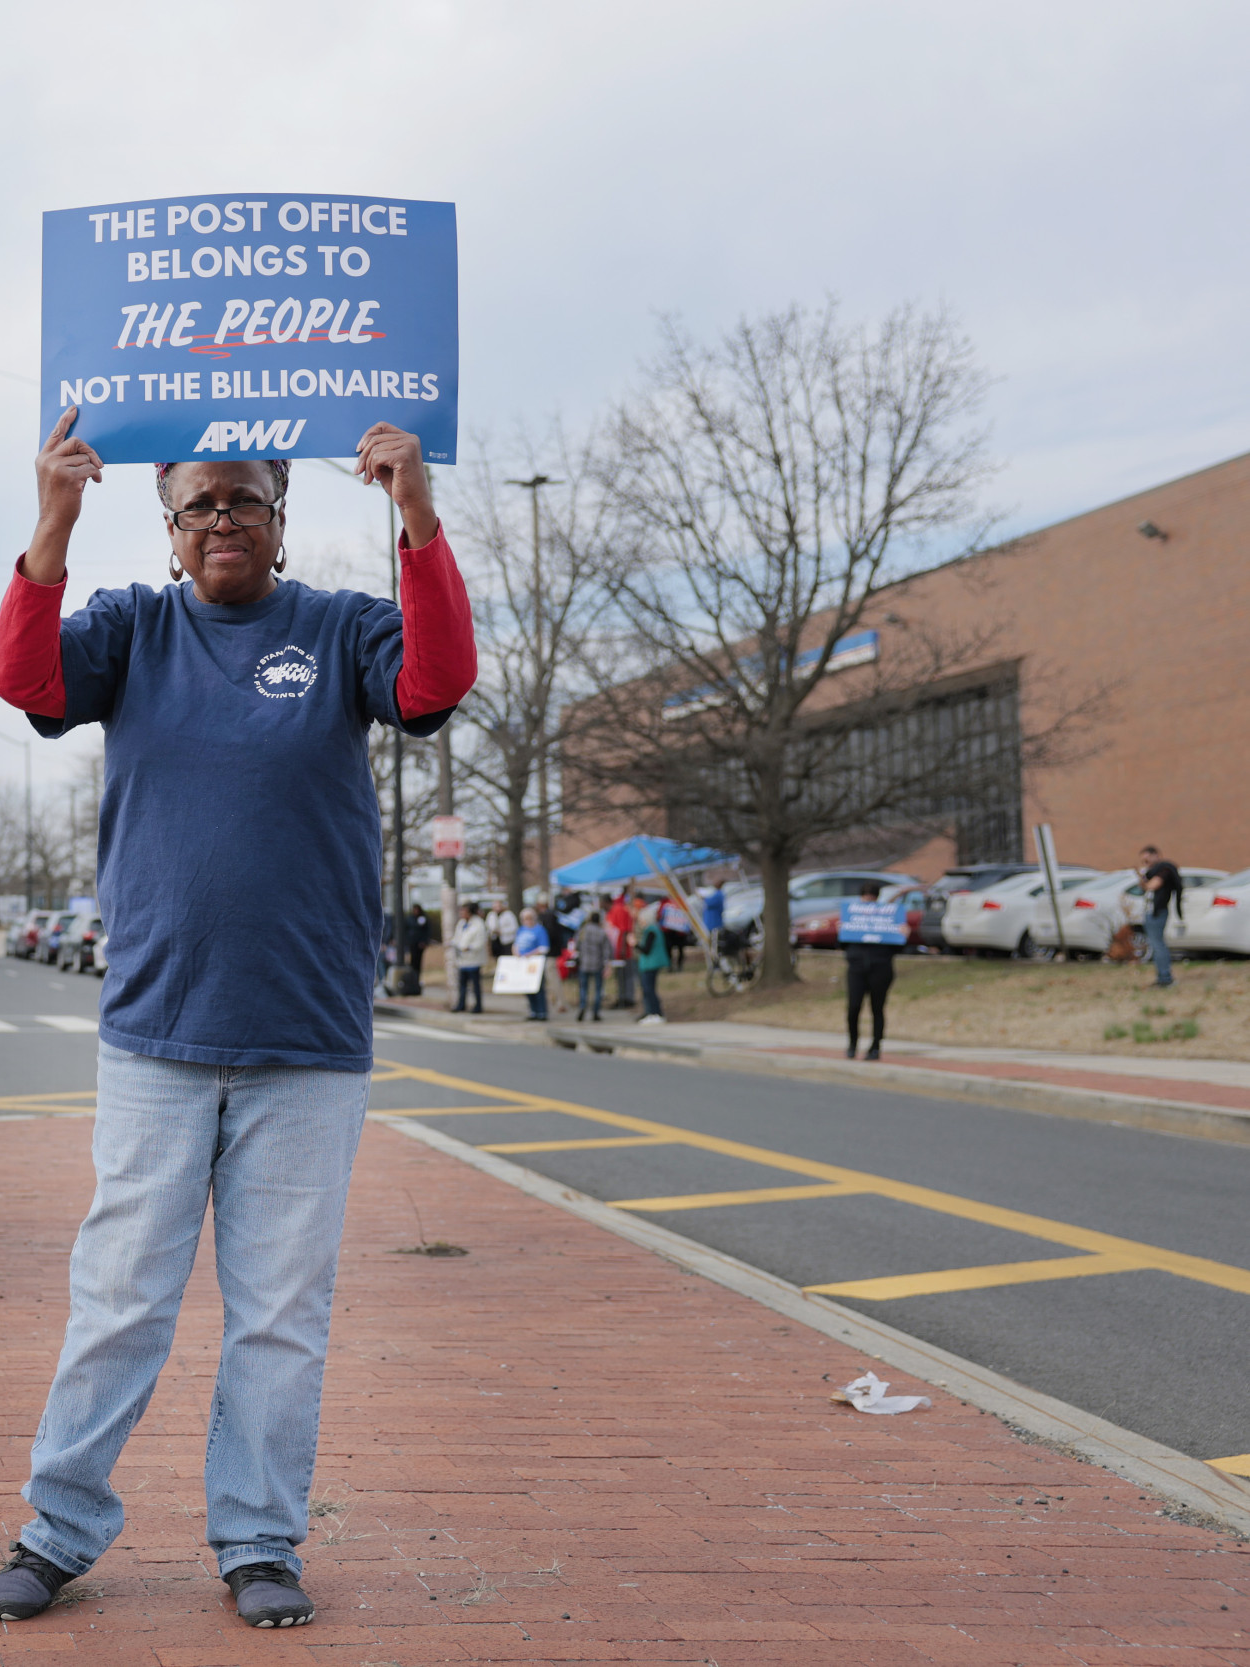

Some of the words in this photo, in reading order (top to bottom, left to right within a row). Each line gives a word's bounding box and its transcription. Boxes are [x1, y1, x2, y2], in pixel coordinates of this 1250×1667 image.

[88, 208, 156, 243] THE
[167, 201, 268, 236] POST
[278, 201, 408, 236] OFFICE
[127, 244, 308, 283] BELONGS
[317, 245, 371, 277] TO
[117, 301, 202, 350] THE
[213, 296, 381, 345] PEOPLE
[59, 375, 130, 407] NOT
[138, 372, 201, 401] THE
[211, 368, 440, 401] BILLIONAIRES
[192, 418, 308, 453] APWU
